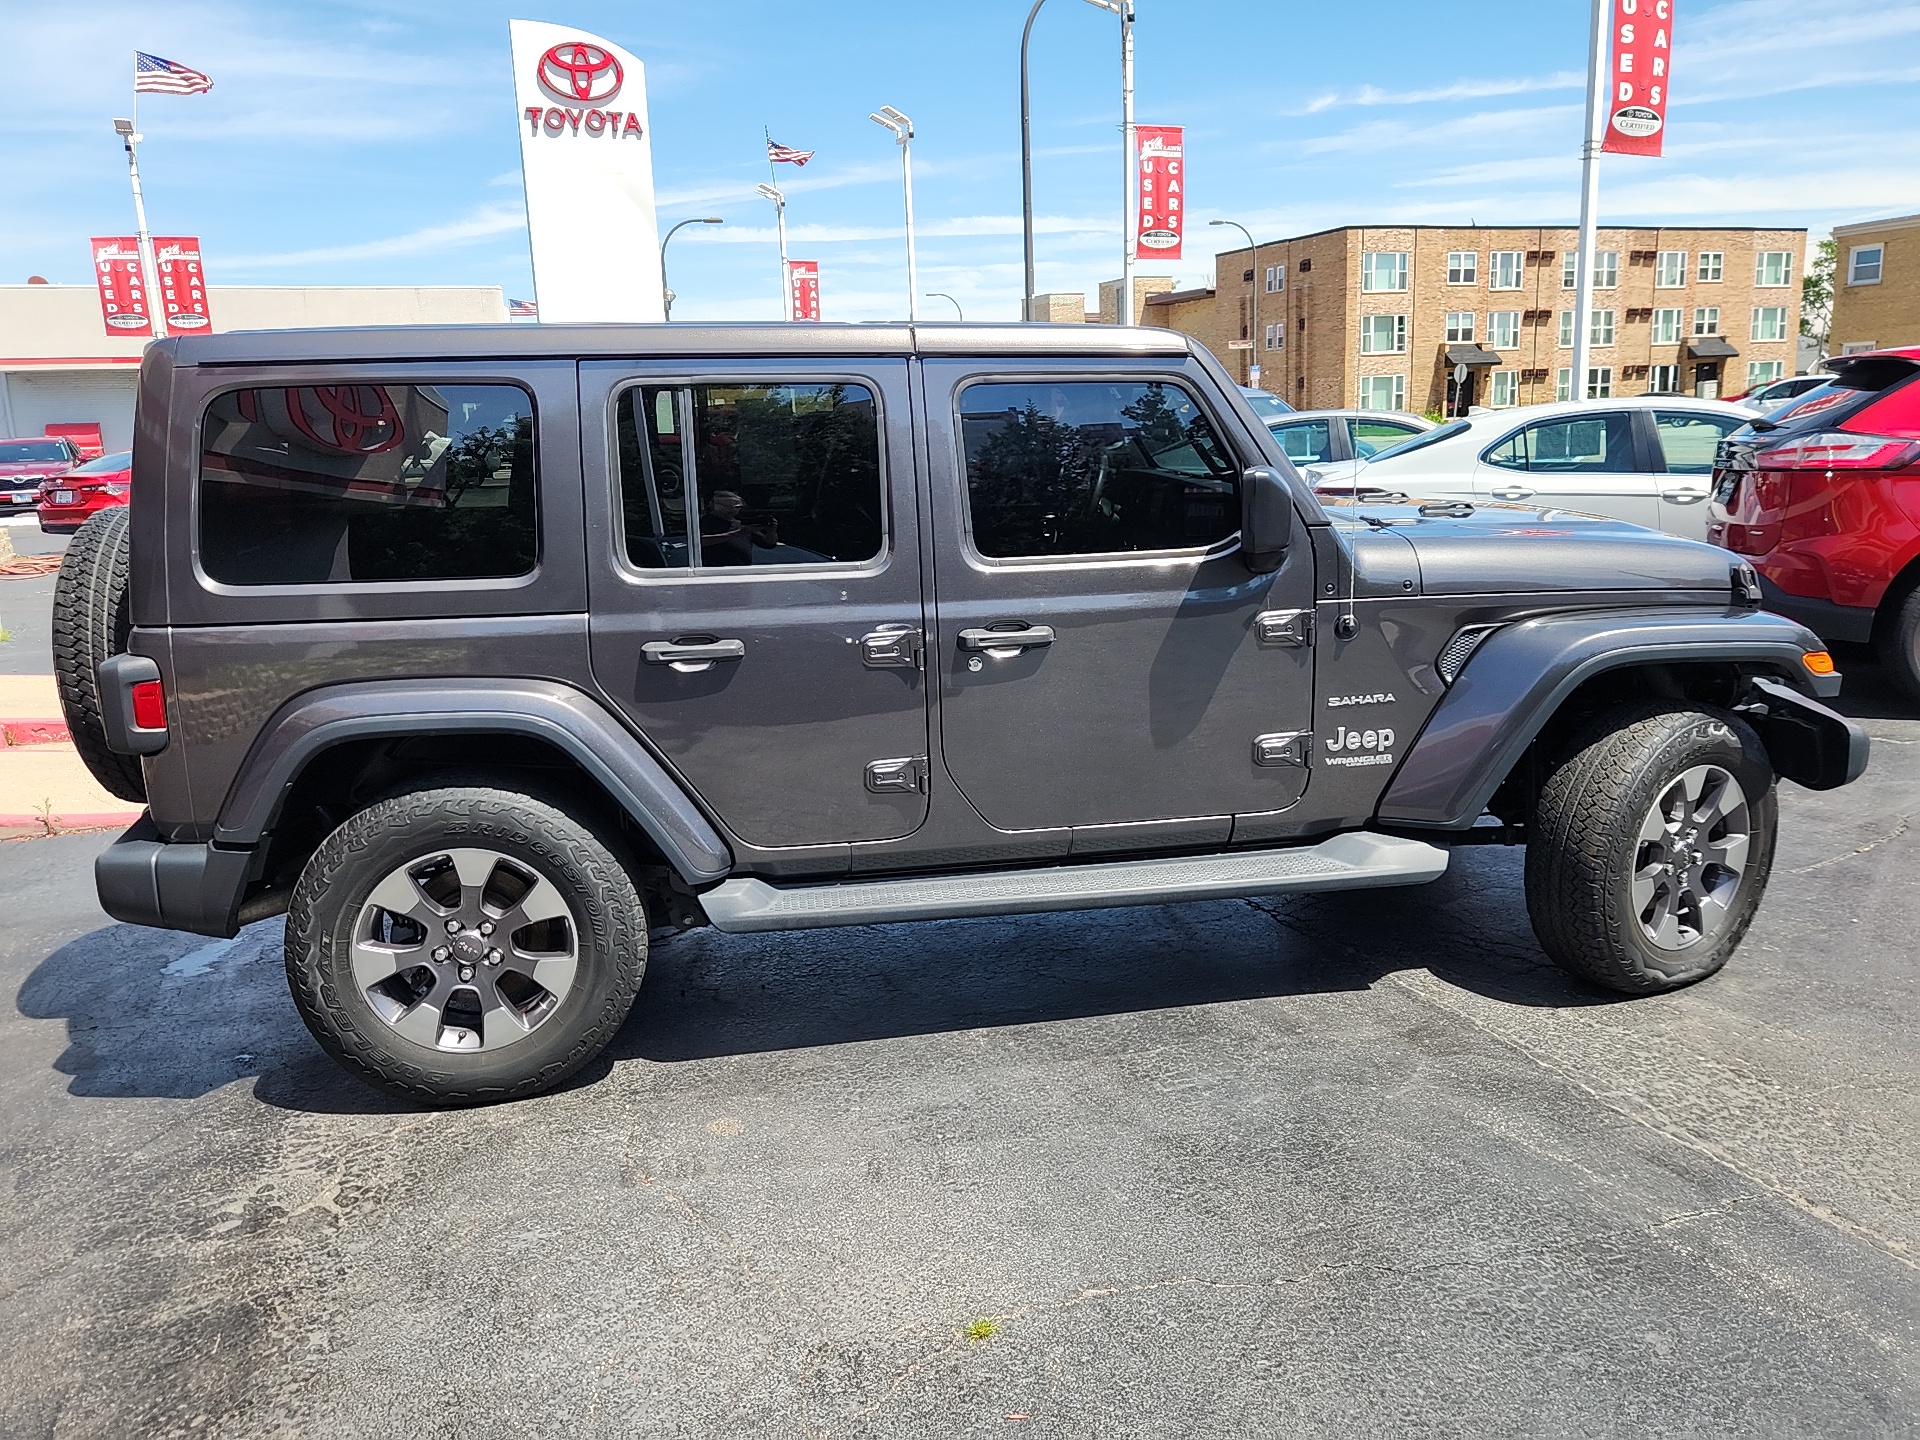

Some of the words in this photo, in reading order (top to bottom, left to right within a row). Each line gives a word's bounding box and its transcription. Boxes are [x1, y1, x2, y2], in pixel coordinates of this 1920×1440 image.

[1618, 0, 1637, 101] USED
[1649, 0, 1669, 106] CARS
[525, 106, 643, 135] TOYOTA
[1143, 160, 1154, 228] USED
[1167, 161, 1180, 229] CARS
[100, 262, 118, 313] USED
[126, 262, 143, 313] CARS
[161, 262, 179, 313] USED
[187, 262, 203, 313] CARS
[809, 280, 818, 318] CARS
[1327, 692, 1396, 707] SAHARA
[1324, 753, 1393, 767] WRANGLER
[1325, 726, 1395, 752] Jeep
[443, 820, 610, 955] BRIDGESTONE
[320, 929, 332, 977] A/T
[319, 982, 456, 1085] DUELER
